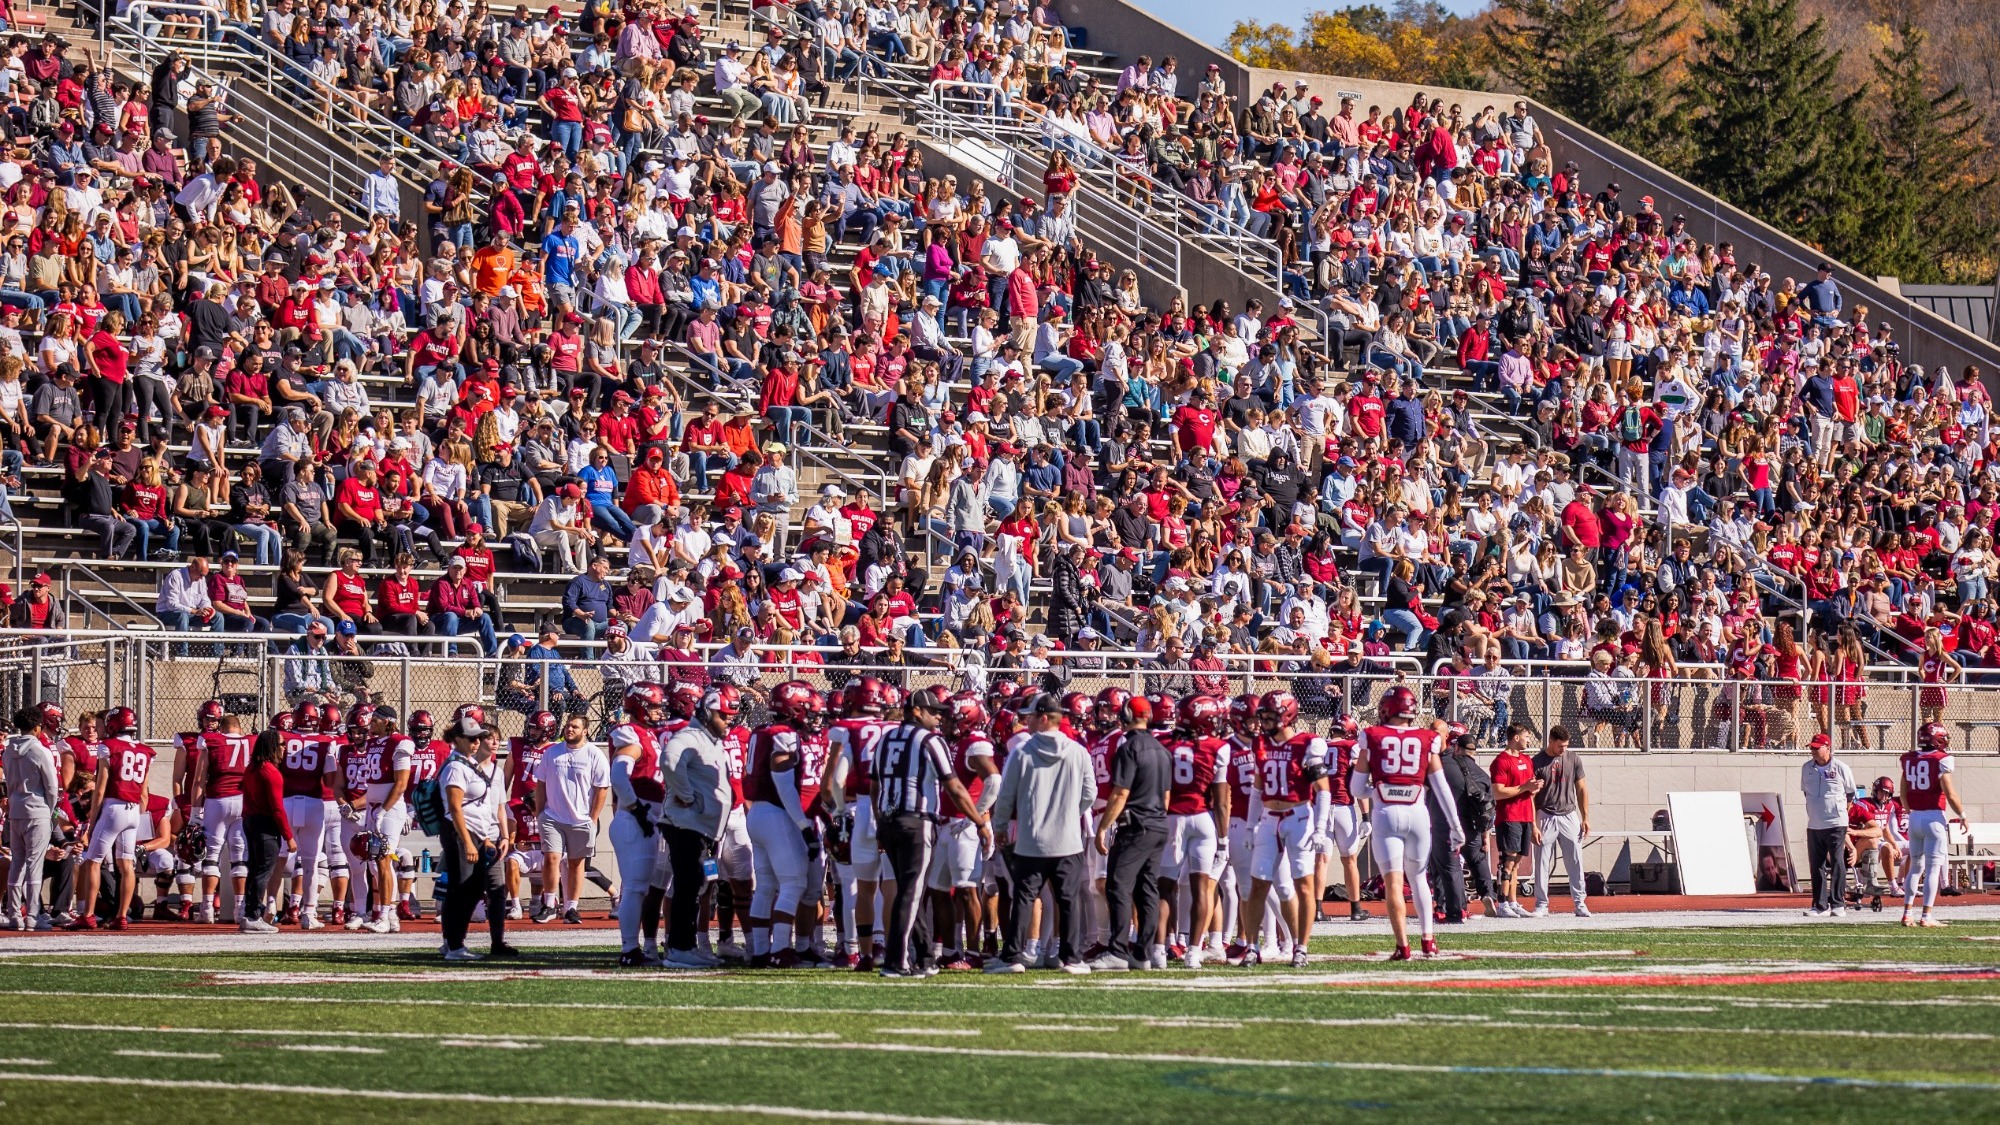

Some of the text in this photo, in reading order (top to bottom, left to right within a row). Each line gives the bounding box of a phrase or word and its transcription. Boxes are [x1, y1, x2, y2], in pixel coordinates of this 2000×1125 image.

[1199, 414, 1209, 423] C
[851, 514, 873, 523] COLGATE
[858, 522, 867, 531] 13
[1733, 648, 1744, 661] C
[1924, 660, 1935, 672] C
[626, 685, 653, 697] gate
[674, 681, 700, 693] gate
[786, 686, 811, 698] gate
[954, 699, 976, 713] gate
[225, 738, 249, 768] 71
[286, 739, 318, 771] 85
[884, 741, 906, 774] F
[1233, 753, 1255, 766] COLG
[1263, 751, 1292, 760] OLGATE
[1380, 737, 1422, 775] 39
[121, 751, 147, 783] 83
[409, 760, 437, 784] 72
[1174, 747, 1194, 785] 8
[1264, 760, 1288, 795] 31
[1904, 759, 1930, 790] 48
[1387, 788, 1412, 797] DOUGLAS
